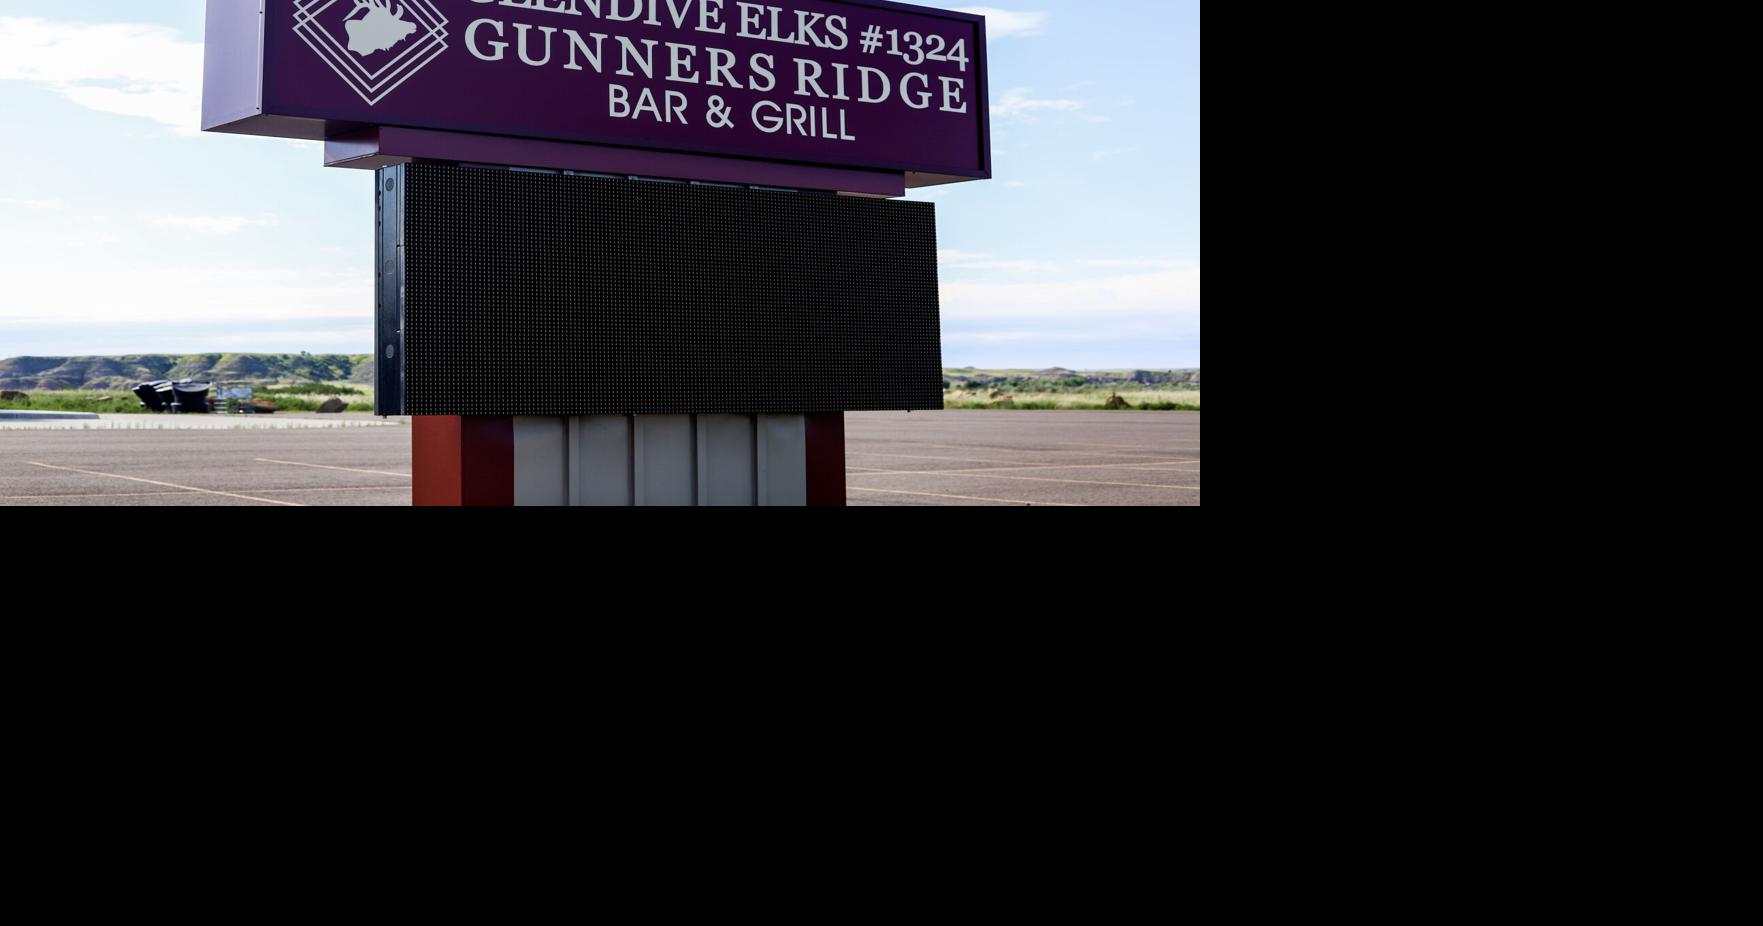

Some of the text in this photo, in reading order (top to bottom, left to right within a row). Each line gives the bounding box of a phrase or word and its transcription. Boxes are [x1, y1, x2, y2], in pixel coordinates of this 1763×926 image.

[464, 18, 967, 114] GUNNERS RIDGE
[736, 1, 849, 51] ELKS
[859, 24, 970, 72] #1324
[608, 84, 856, 141] BAR & GRILL
